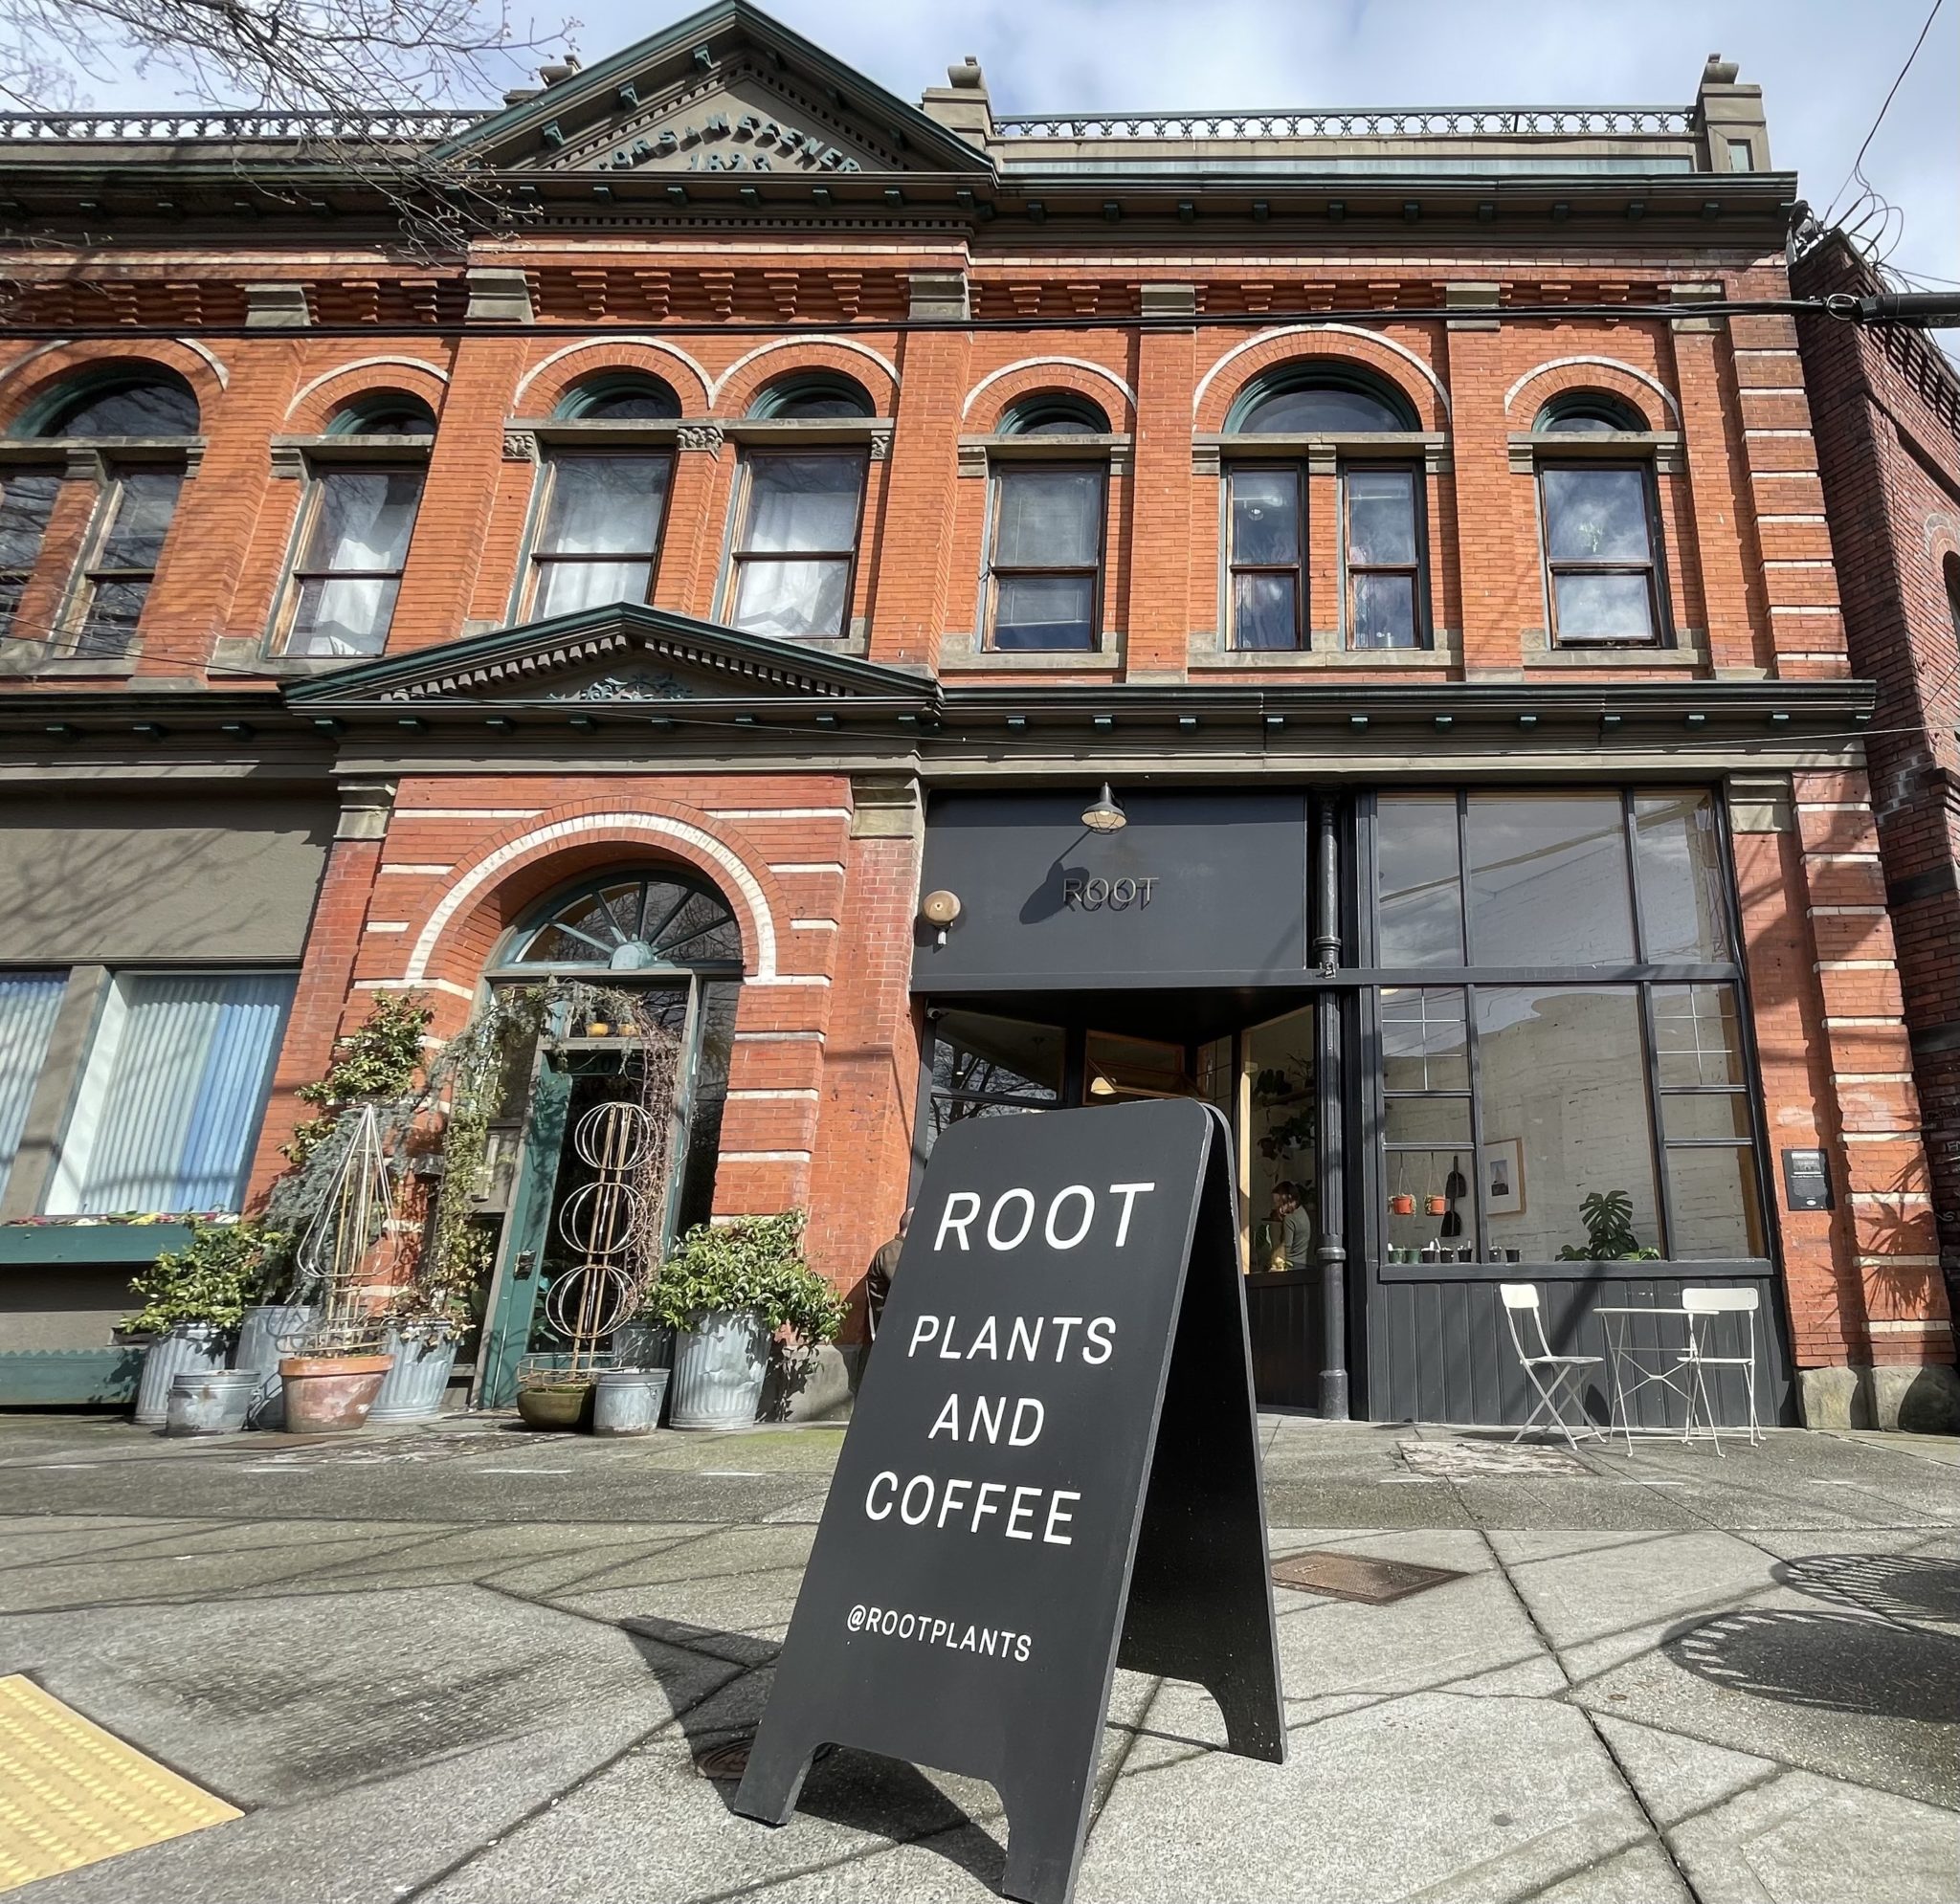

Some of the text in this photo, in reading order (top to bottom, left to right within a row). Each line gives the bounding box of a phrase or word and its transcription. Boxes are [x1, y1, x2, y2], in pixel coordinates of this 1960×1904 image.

[690, 151, 772, 170] 1893
[1063, 877, 1160, 903] ROOT
[933, 1182, 1156, 1251] ROOT
[907, 1315, 1117, 1365] PLANTS
[927, 1393, 1045, 1447] AND
[865, 1471, 1081, 1545] COFFEE
[846, 1604, 1033, 1662] @ROOTPLANTS
